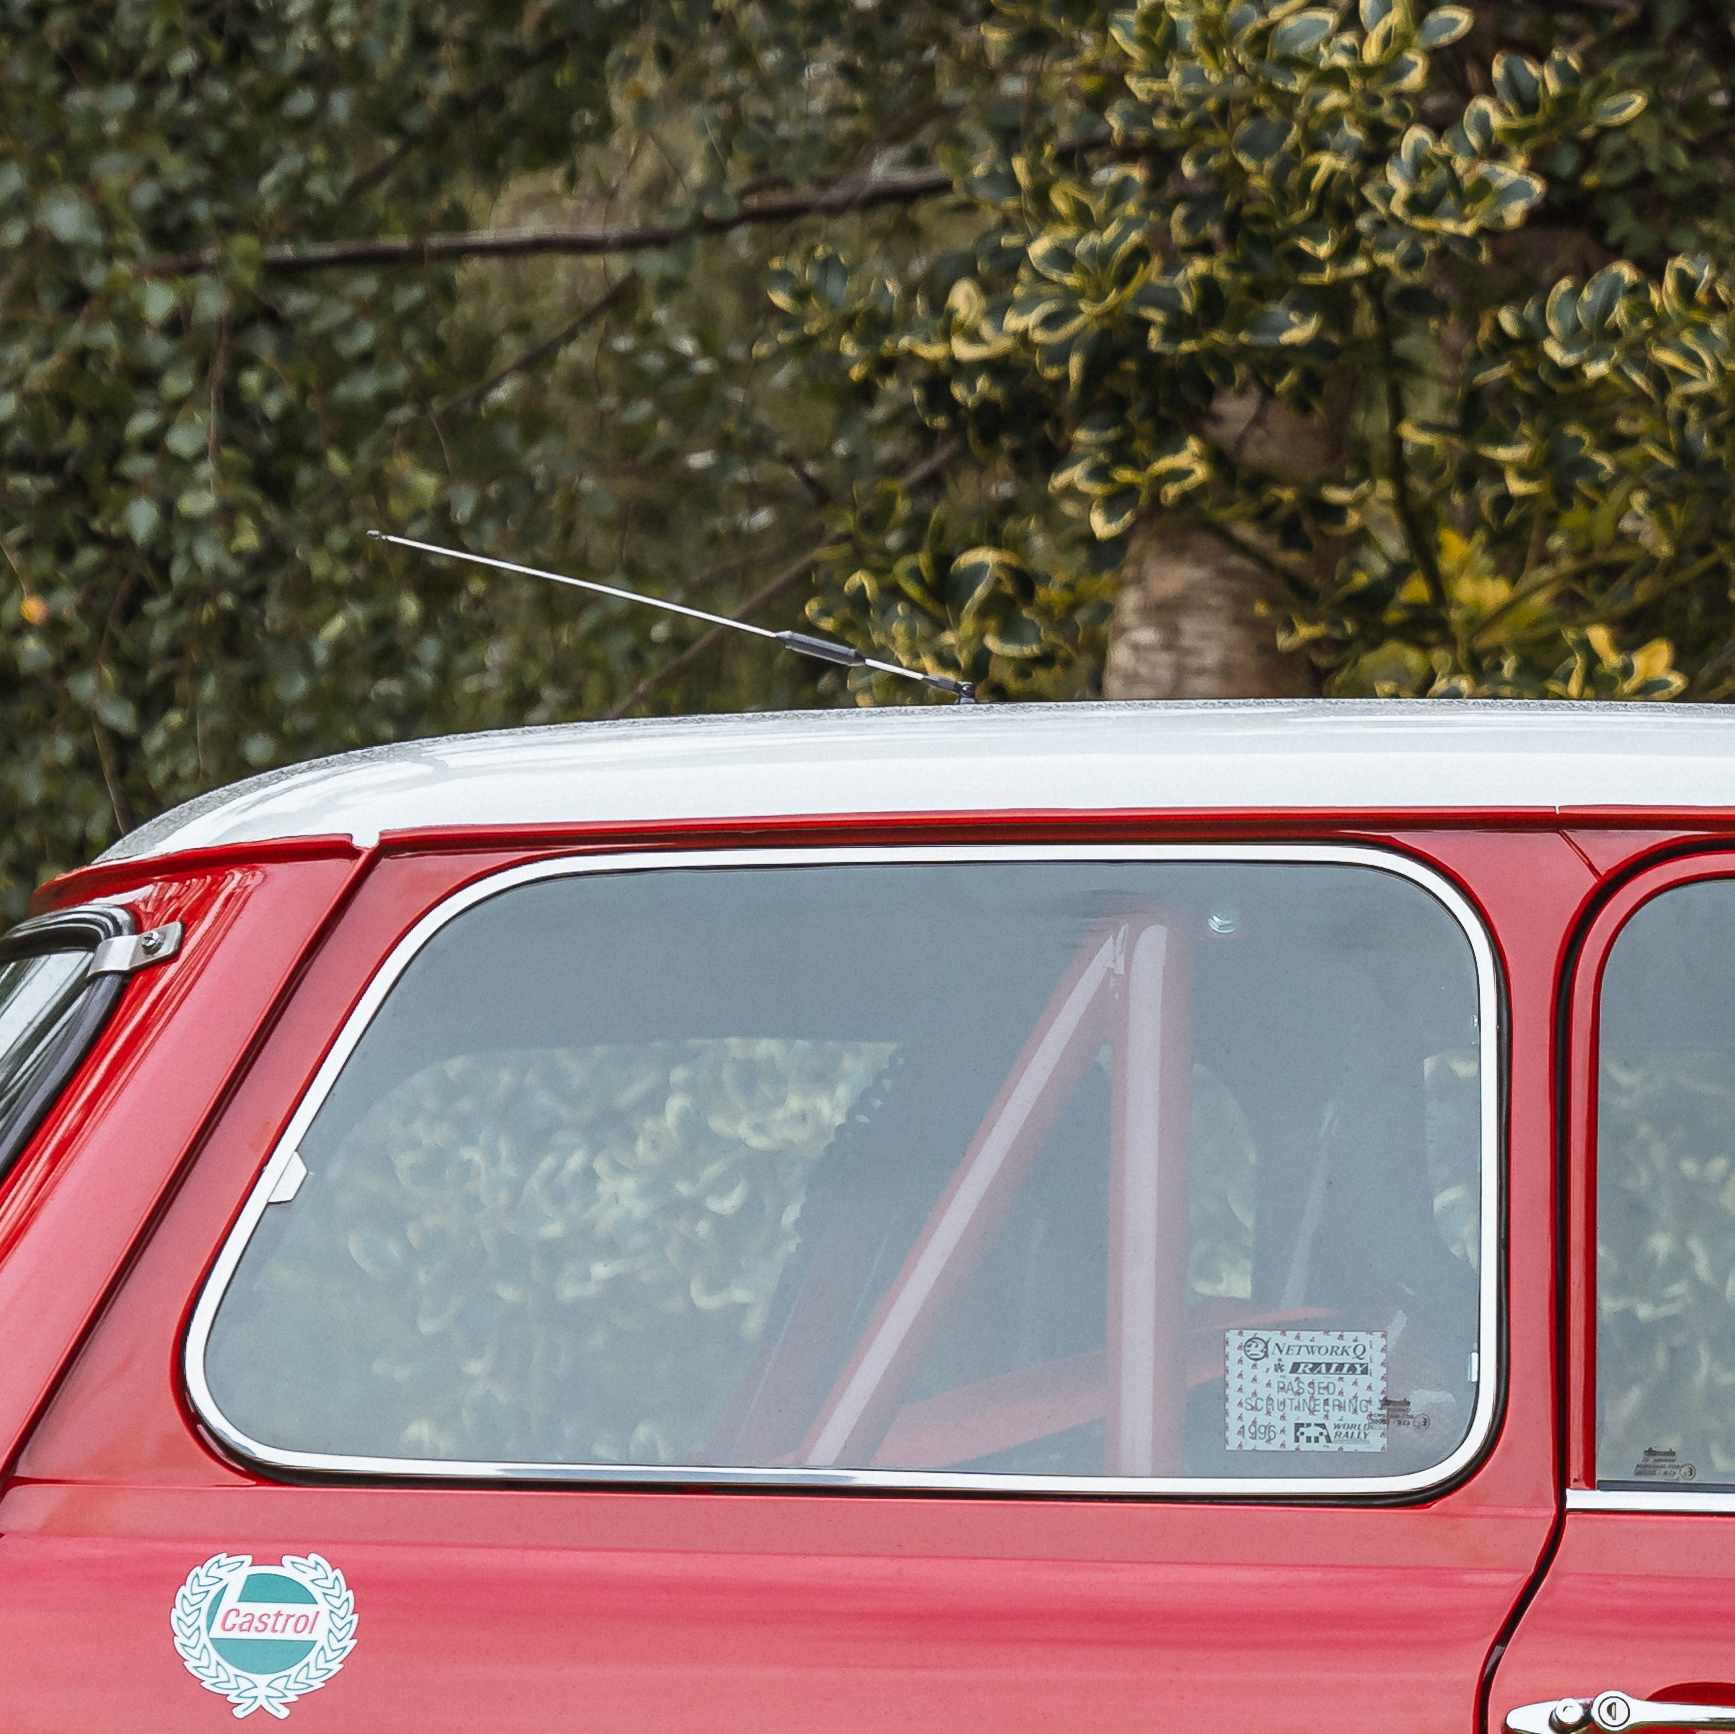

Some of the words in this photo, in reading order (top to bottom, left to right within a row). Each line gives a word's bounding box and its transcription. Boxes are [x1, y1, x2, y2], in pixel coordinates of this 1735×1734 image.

[1297, 1362, 1367, 1375] RALLY
[1276, 1380, 1337, 1396] PASSED
[1243, 1398, 1369, 1413] SCRUTINEERING
[1239, 1424, 1278, 1441] 1996
[1333, 1431, 1371, 1440] RALLY
[220, 1608, 320, 1634] Castrol
